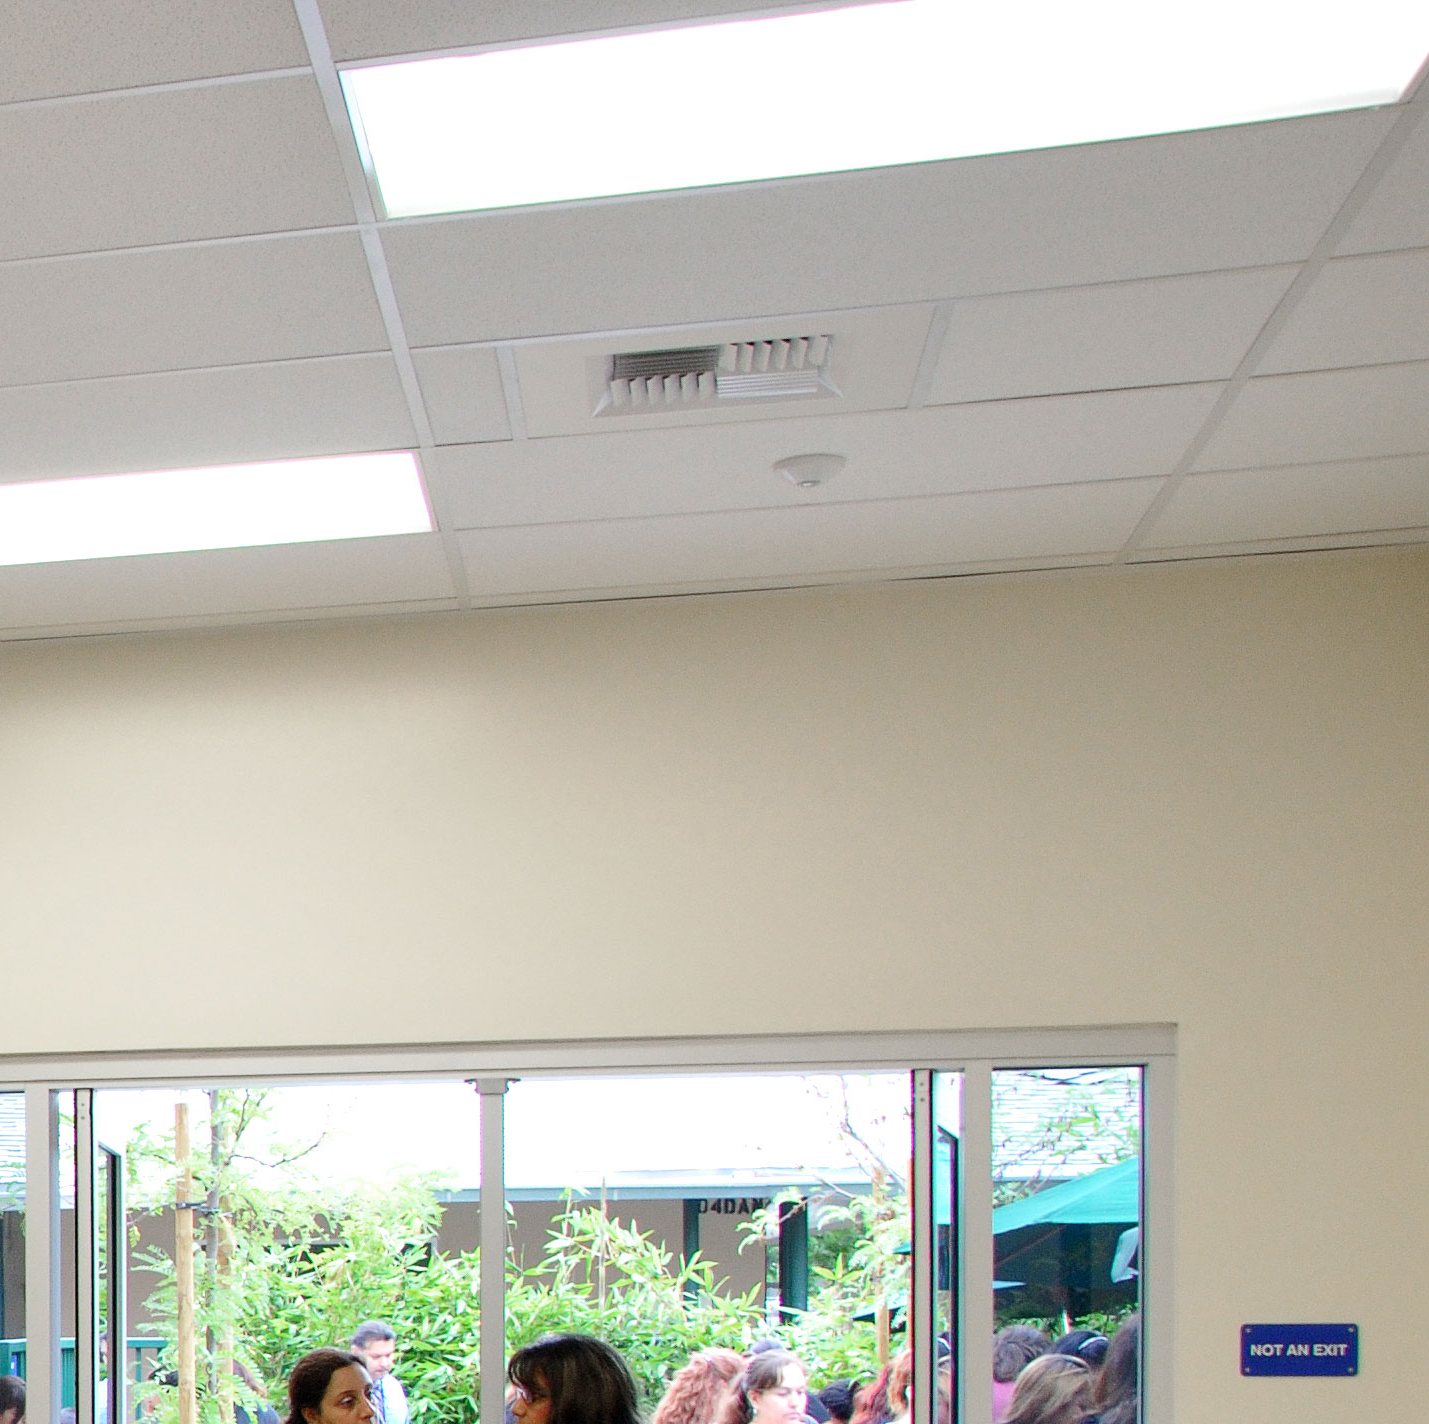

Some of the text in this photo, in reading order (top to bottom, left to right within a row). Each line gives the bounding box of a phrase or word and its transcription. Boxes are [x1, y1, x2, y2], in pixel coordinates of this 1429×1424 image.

[1250, 1344, 1348, 1356] NOT AN EXIT
